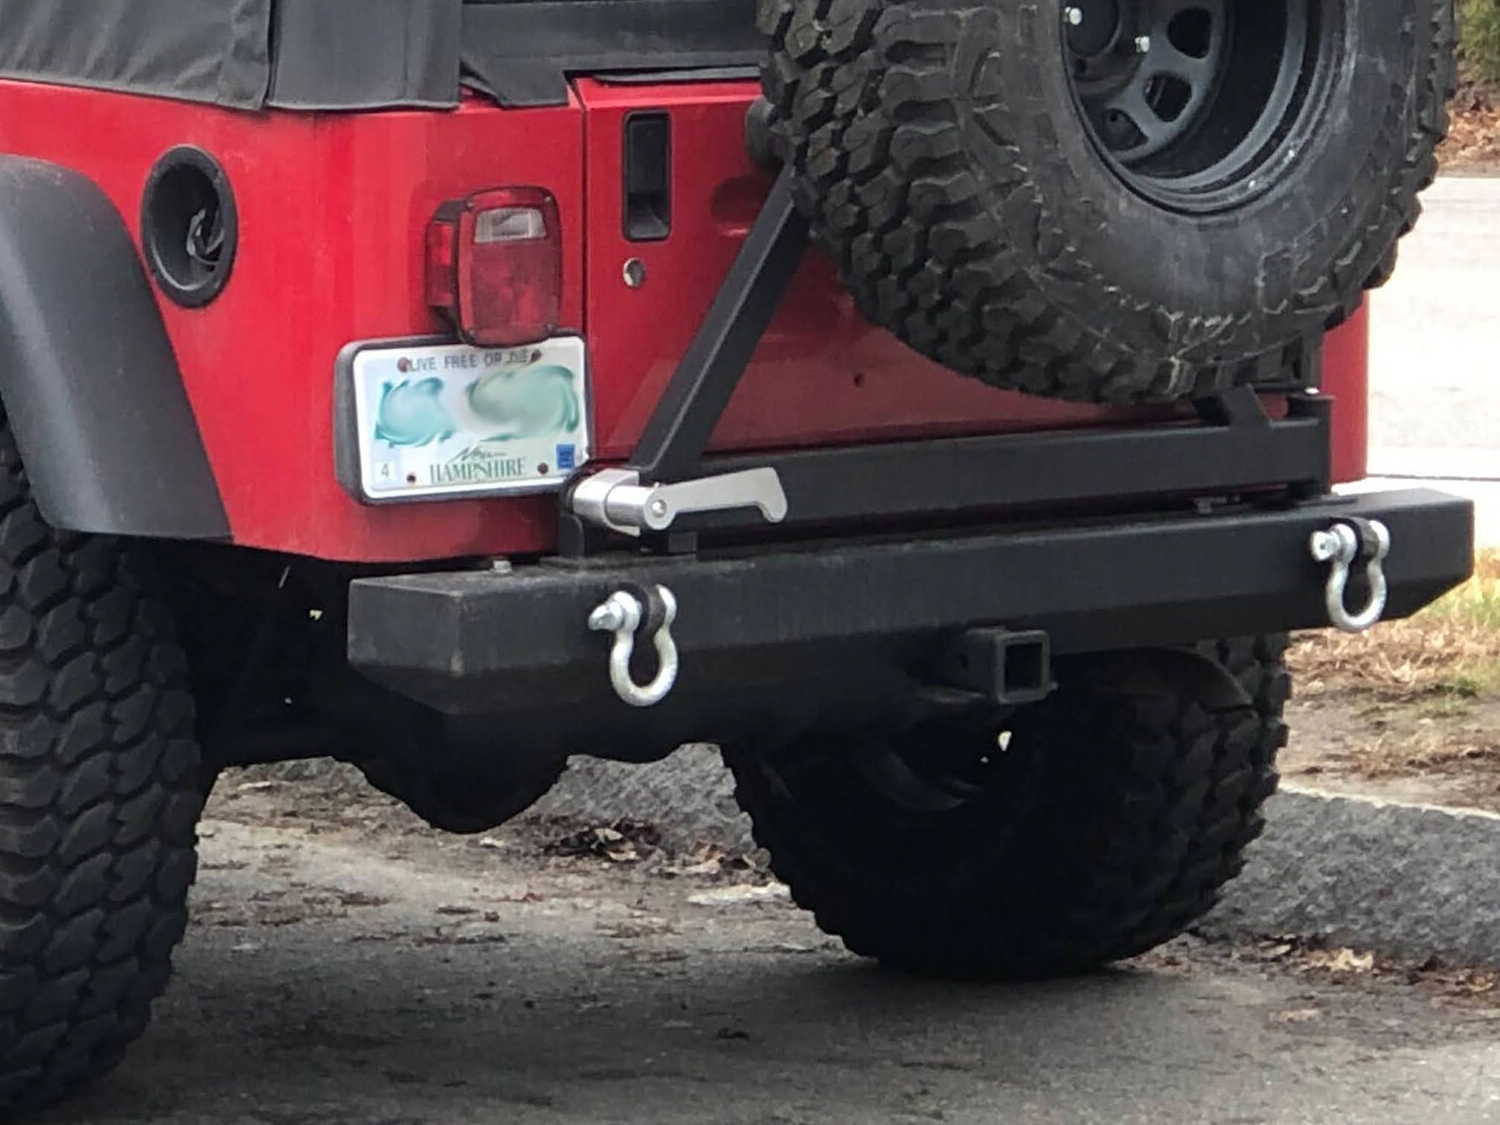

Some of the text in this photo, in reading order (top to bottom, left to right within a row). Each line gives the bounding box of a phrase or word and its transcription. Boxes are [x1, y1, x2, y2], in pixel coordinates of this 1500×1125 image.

[410, 357, 437, 372] LIVE
[444, 353, 477, 369] FREE
[380, 464, 390, 477] 4
[429, 455, 526, 484] HAMPSHIRE
